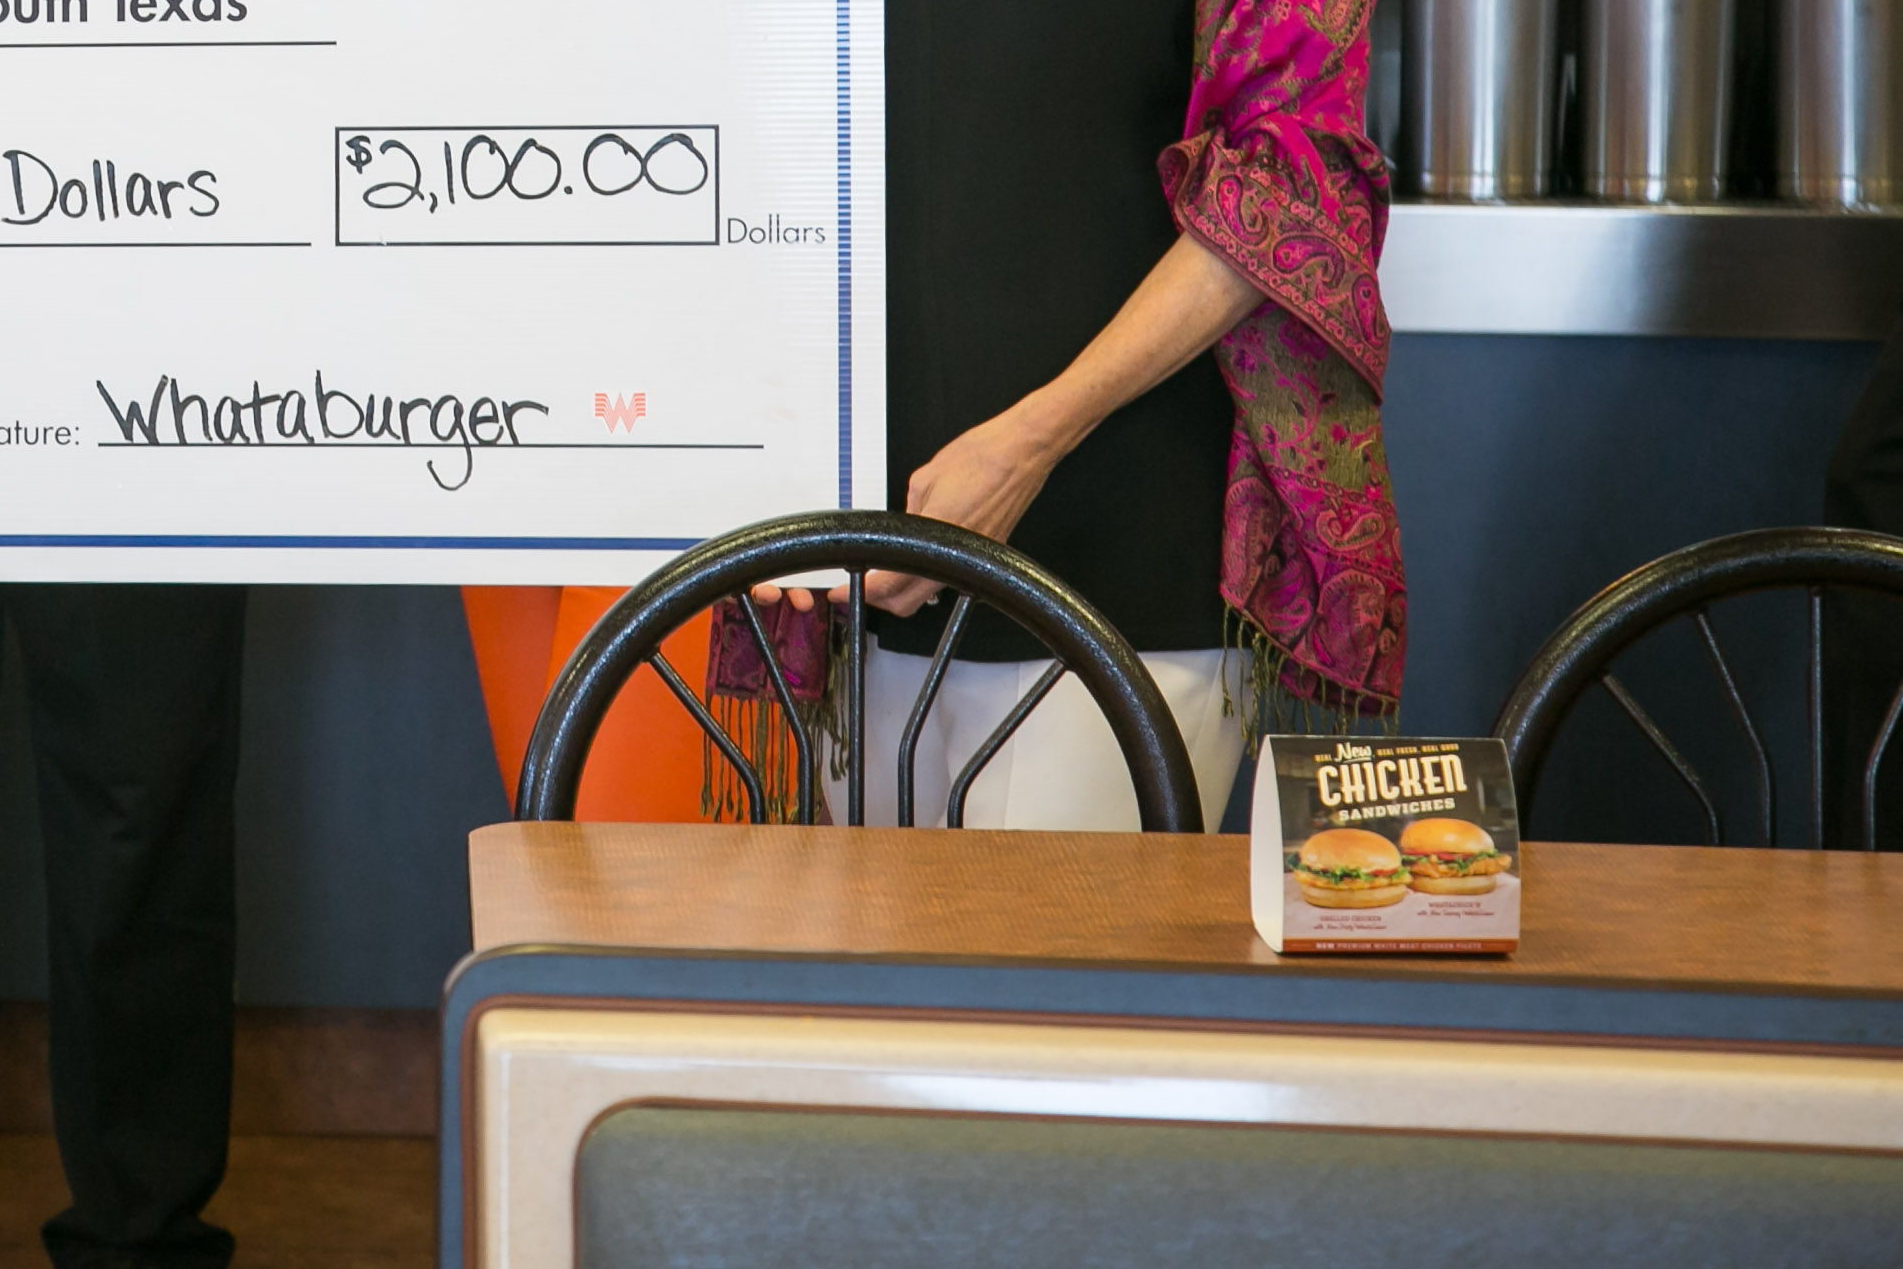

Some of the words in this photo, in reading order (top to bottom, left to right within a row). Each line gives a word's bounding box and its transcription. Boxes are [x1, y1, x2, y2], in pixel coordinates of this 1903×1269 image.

[1, 149, 221, 226] Dollars
[345, 133, 709, 215] $2,100.00
[727, 214, 827, 245] Dollars
[97, 370, 549, 490] Whataburger
[1317, 753, 1468, 807] CHICKEN
[1339, 798, 1455, 821] SANDWICHES
